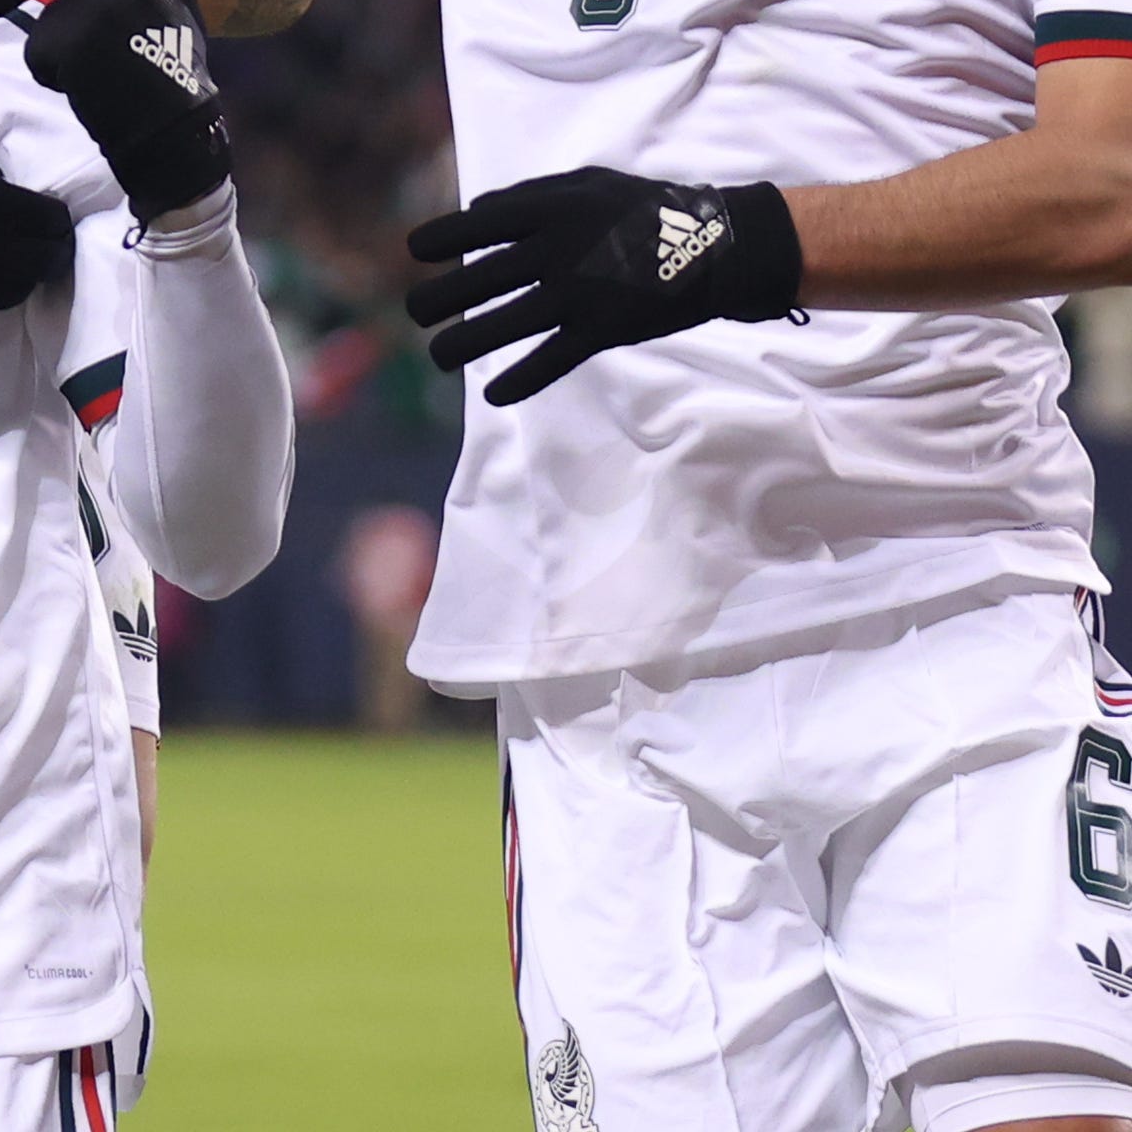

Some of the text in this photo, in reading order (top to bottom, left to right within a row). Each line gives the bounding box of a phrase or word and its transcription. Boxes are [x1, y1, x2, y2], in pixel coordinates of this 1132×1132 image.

[129, 34, 199, 95] adidas
[658, 219, 725, 281] adidas
[1066, 723, 1132, 910] 6
